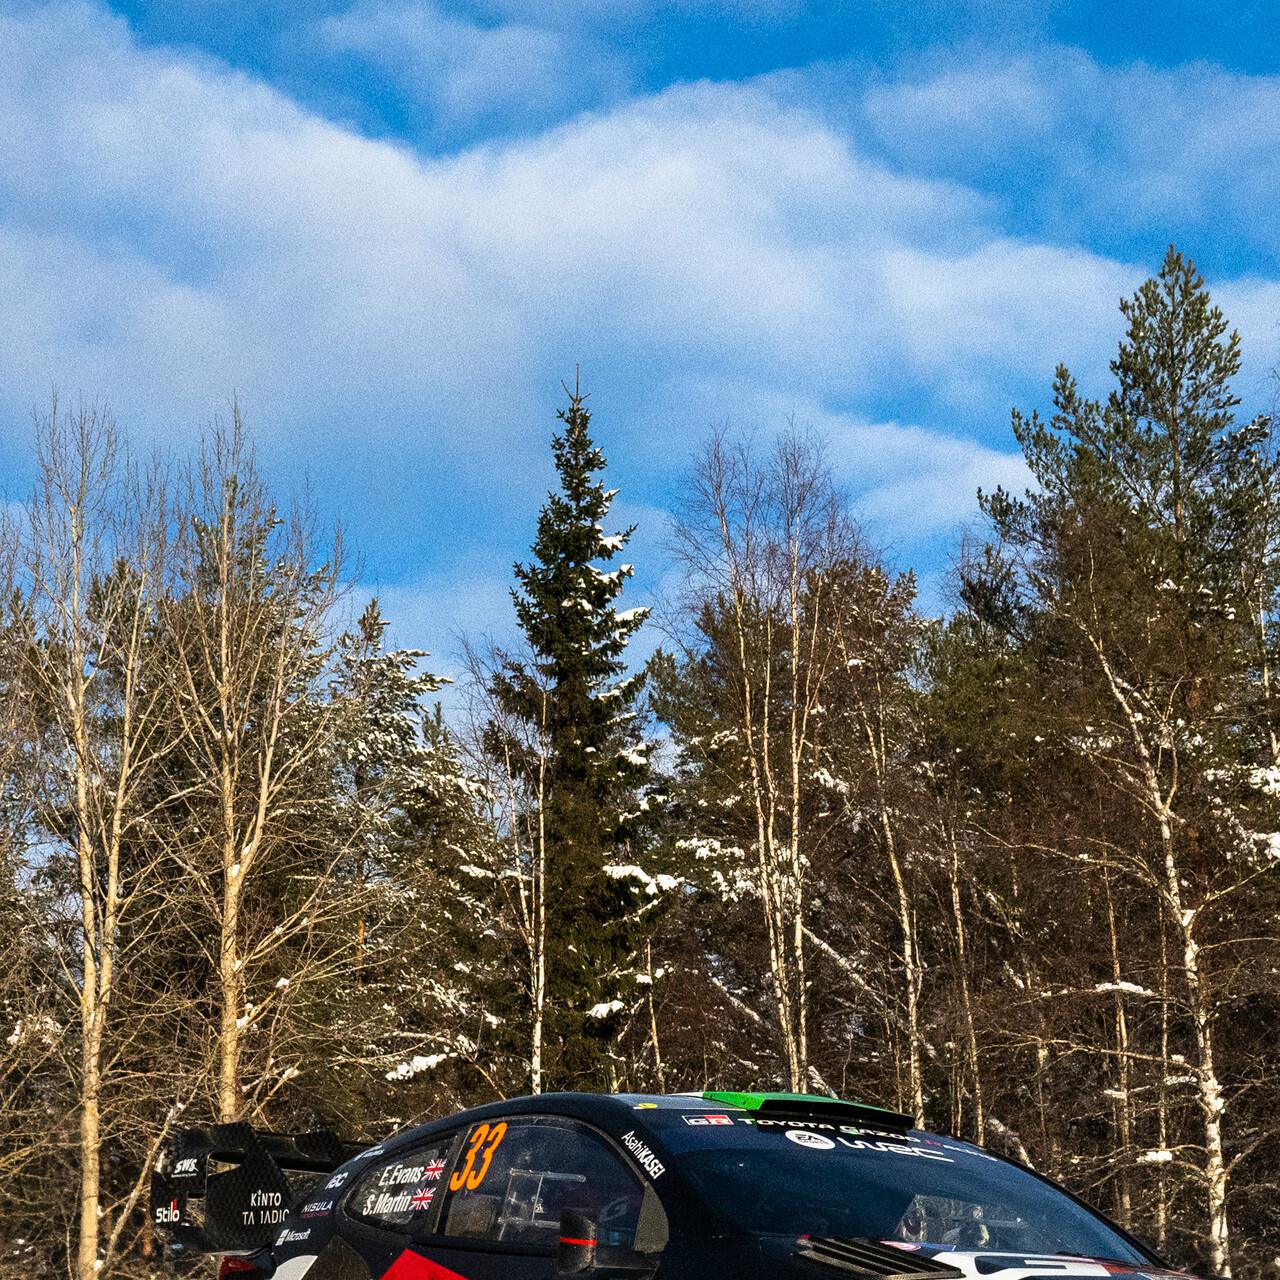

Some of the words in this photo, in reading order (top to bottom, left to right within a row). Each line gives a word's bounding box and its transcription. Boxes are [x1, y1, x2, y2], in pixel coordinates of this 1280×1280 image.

[737, 1118, 836, 1130] TOYOTA
[449, 1122, 508, 1192] 33
[621, 1130, 666, 1180] AsahiKASEI
[837, 1137, 955, 1163] WRC
[378, 1164, 426, 1187] E.Evans
[155, 1198, 180, 1223] Stilo
[301, 1200, 333, 1213] NISULA
[362, 1191, 412, 1216] S.Martin
[286, 1228, 312, 1241] Microsoft
